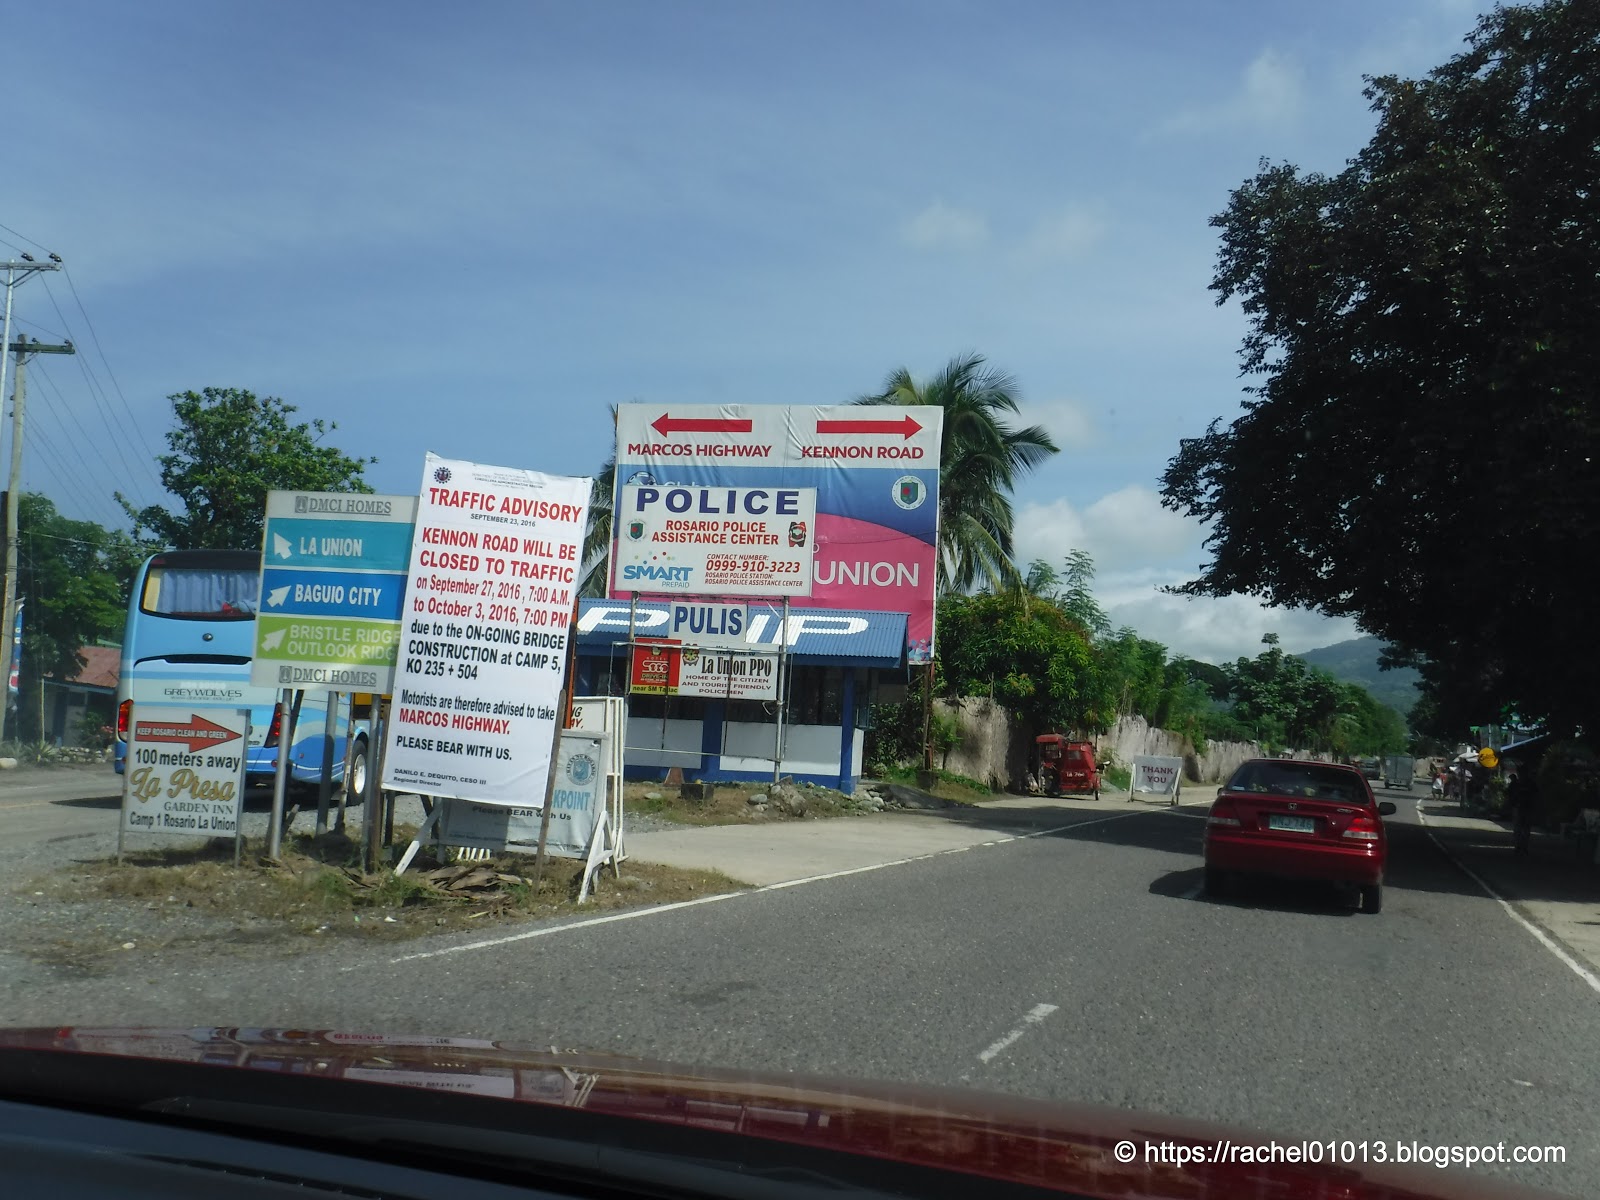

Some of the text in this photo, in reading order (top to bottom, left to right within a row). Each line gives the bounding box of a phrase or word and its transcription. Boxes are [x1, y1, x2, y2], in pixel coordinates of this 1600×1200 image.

[627, 443, 772, 458] MARCOS HIGHWAY
[802, 445, 924, 459] KENNON ROAD
[308, 501, 392, 515] DMCI HOMES
[430, 488, 582, 523] TRAFFIC ADVISORY
[636, 488, 799, 515] POLICE
[470, 513, 536, 527] SEPTEMBER 23, 2016
[666, 520, 766, 533] ROSARIO POLICE
[300, 537, 362, 557] LA UNION
[422, 527, 577, 561] KENNON ROAD WILL BE
[652, 532, 778, 545] ASSISTANCE CENTER
[420, 550, 574, 584] CLOSED TO TRAFFIC
[624, 565, 693, 581] SMART
[706, 561, 800, 573] 0999-910-3223
[814, 561, 919, 587] UNION
[295, 584, 382, 606] BAGUIO CITY
[416, 577, 427, 590] on
[430, 574, 479, 596] September
[481, 580, 495, 600] 27,
[529, 586, 548, 603] 7:00
[550, 588, 570, 606] A.M.
[414, 597, 568, 629] to October 3, 2016, 7:00 PM
[674, 606, 742, 635] PULIS
[290, 625, 350, 642] BRISTLE
[411, 619, 565, 650] due to the ON-GOING BRIDGE
[287, 641, 397, 661] OUTLOOK RIDG
[409, 639, 561, 674] CONSTRUCTION at CAMP 5,
[294, 669, 377, 684] DMCI HOMES
[424, 659, 445, 677] 235
[457, 663, 478, 680] 504
[701, 656, 772, 677] La Unon PPO
[164, 688, 243, 699] GREYWOLVES
[401, 689, 437, 707] Motorists
[439, 697, 452, 709] are
[454, 695, 492, 713] therefore
[492, 699, 525, 717] advised
[527, 706, 535, 718] to
[537, 705, 555, 721] take
[399, 708, 510, 735] MARCOS HIGHWAY.
[152, 728, 176, 737] ROSARIO
[177, 729, 195, 737] CLEAN
[196, 730, 208, 738] AND
[208, 731, 227, 739] GREEN
[396, 735, 512, 761] PLEASE BEAR WITH US.
[136, 749, 241, 773] 100 meters away
[1141, 765, 1173, 776] THANK
[393, 776, 442, 787] Regional Director
[394, 768, 418, 776] DANILO
[1147, 775, 1167, 785] YOU
[130, 767, 235, 803] La Presa
[164, 801, 233, 815] GARDEN INN
[553, 790, 591, 811] KPOINT
[130, 811, 154, 828] Camp
[164, 813, 195, 829] Rosario
[198, 816, 209, 829] La
[211, 816, 236, 831] Union
[472, 805, 504, 815] Please
[506, 808, 533, 817] BEAR
[559, 813, 572, 821] Us
